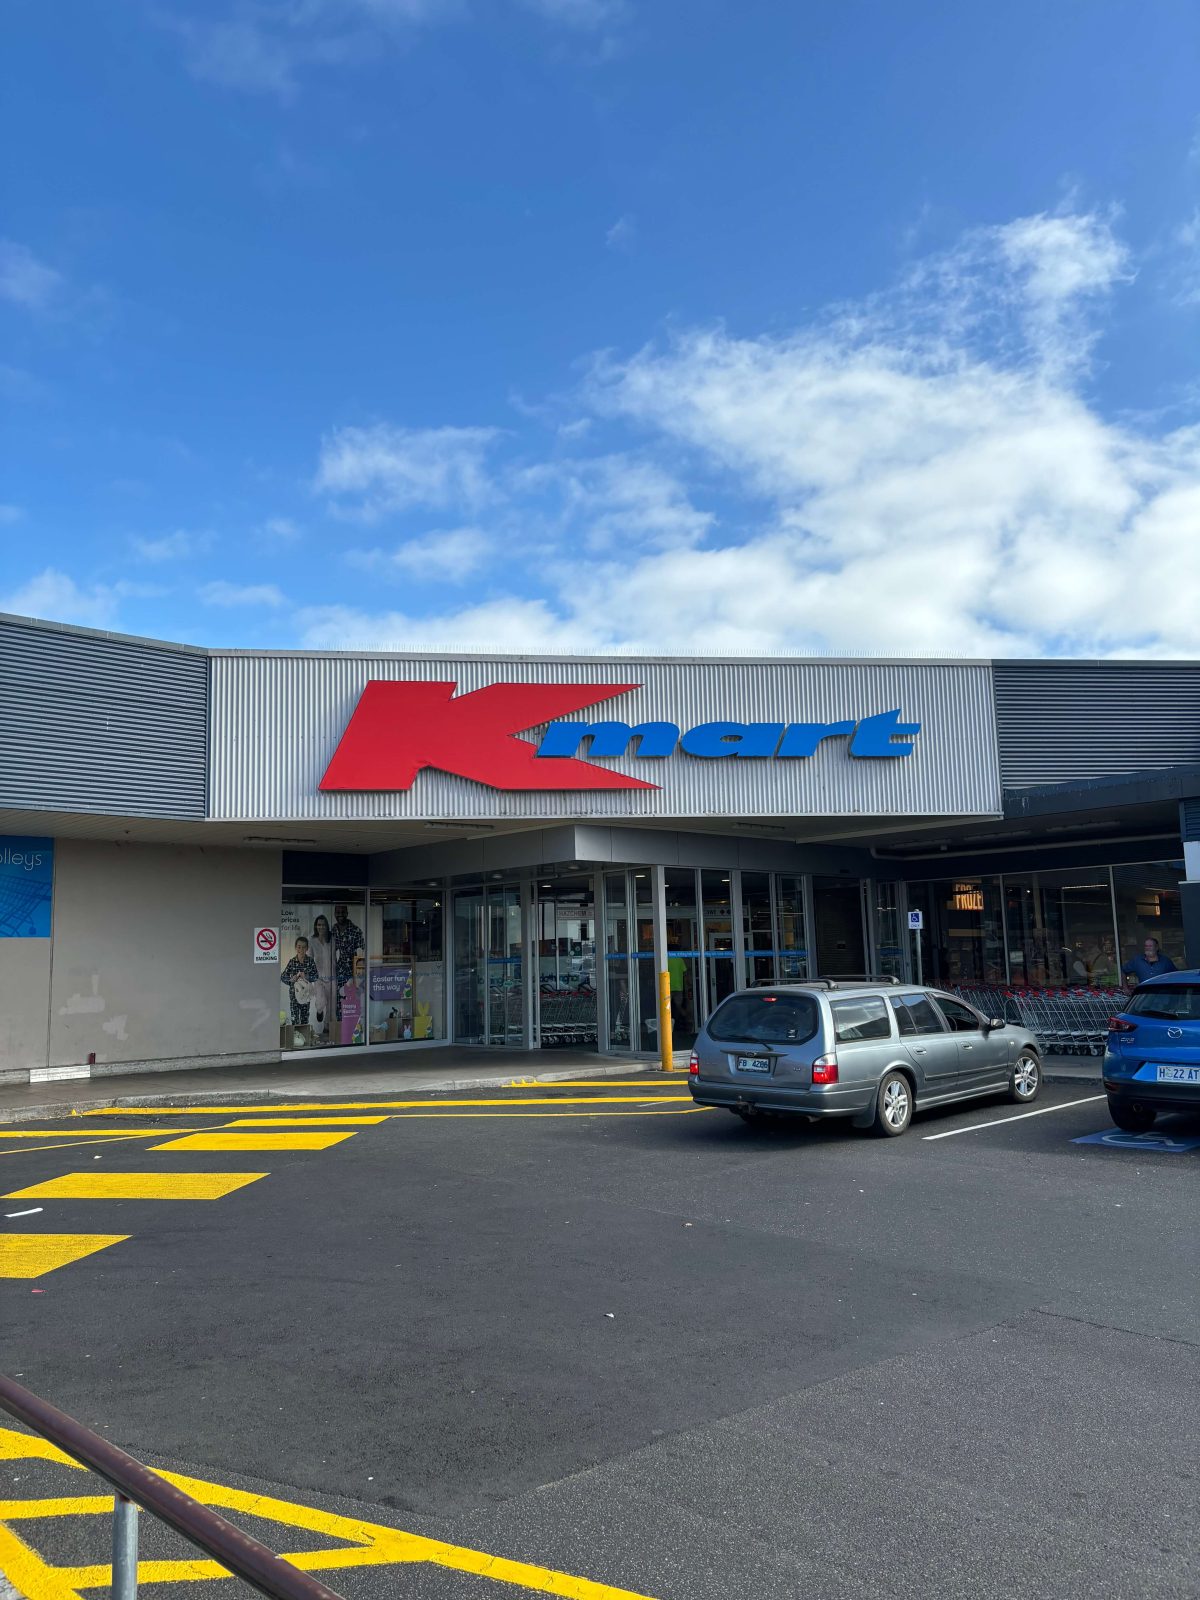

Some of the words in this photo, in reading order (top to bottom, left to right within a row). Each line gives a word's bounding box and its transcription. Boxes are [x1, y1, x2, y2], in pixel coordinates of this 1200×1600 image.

[318, 679, 922, 791] Kmart
[0, 847, 42, 871] lleys
[955, 883, 985, 910] FROZE
[372, 975, 393, 983] Easter
[394, 974, 406, 982] fun
[372, 983, 385, 991] this
[1159, 1067, 1166, 1078] H
[1173, 1068, 1185, 1079] 22
